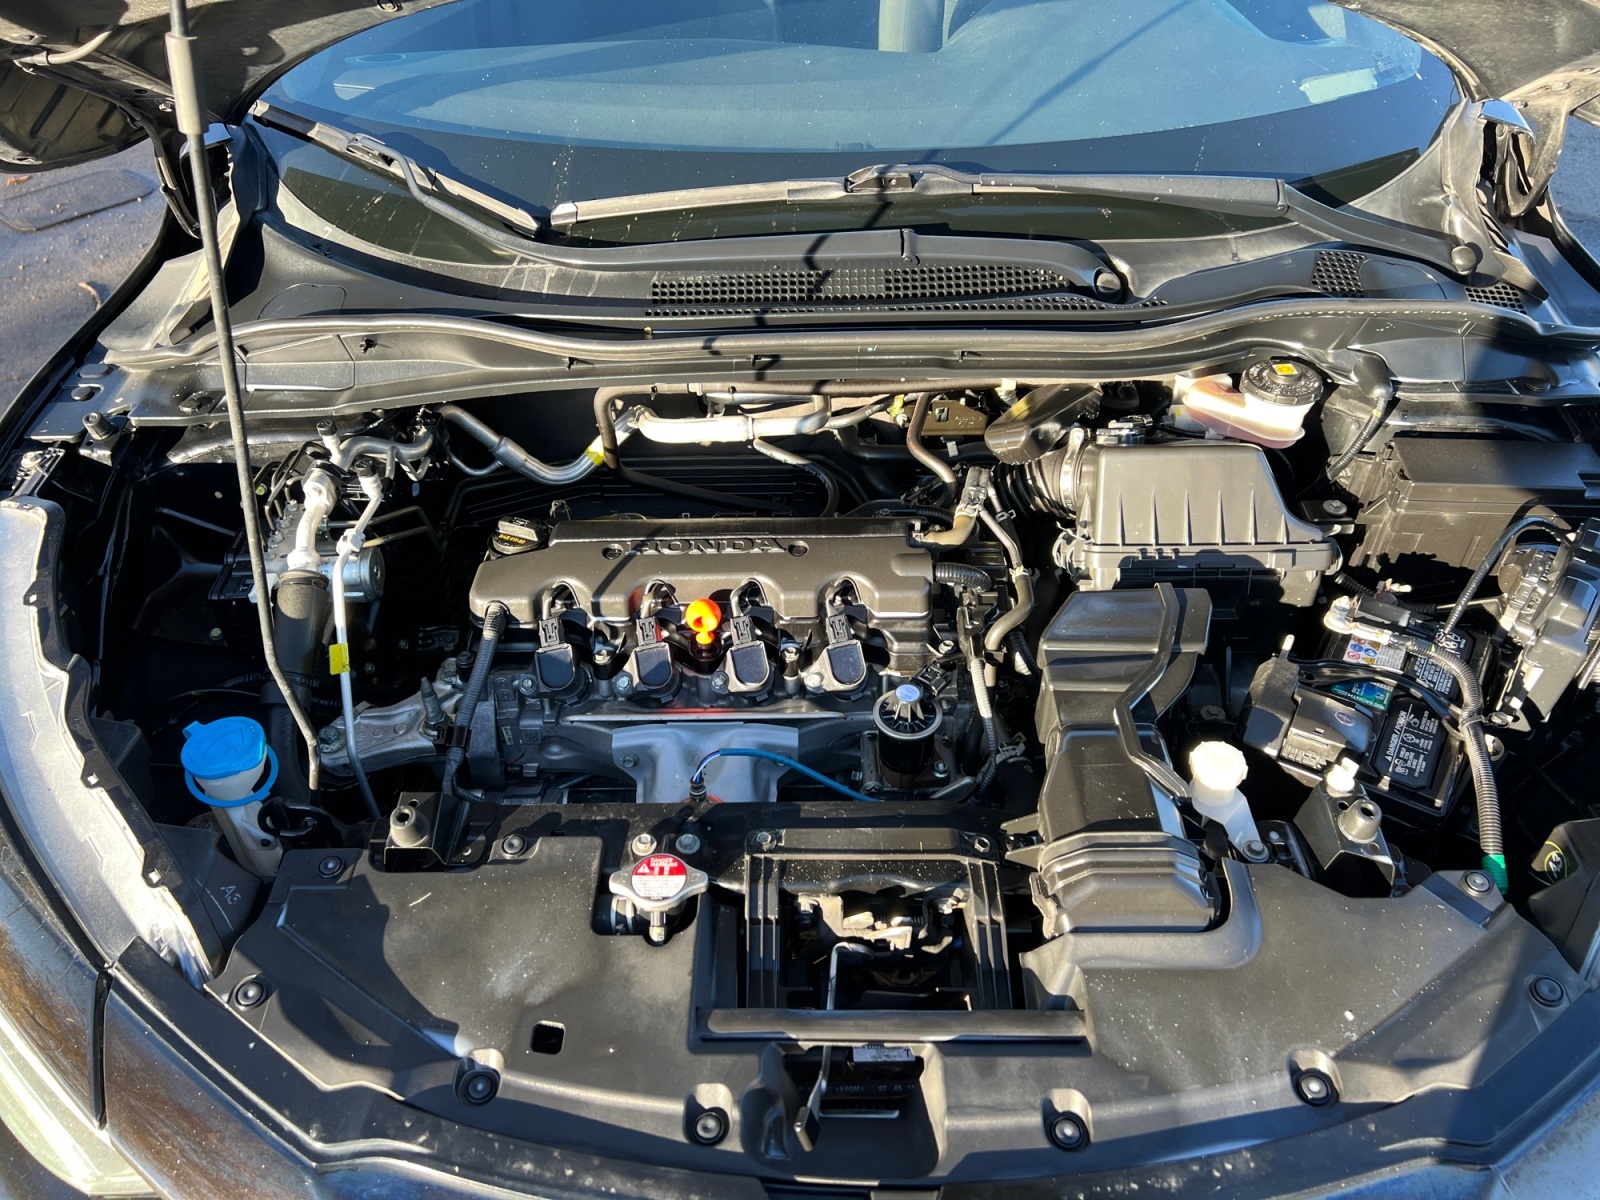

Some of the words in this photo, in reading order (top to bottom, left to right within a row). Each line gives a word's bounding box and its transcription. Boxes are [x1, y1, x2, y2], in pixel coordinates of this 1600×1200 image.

[625, 538, 786, 555] HONDA
[1347, 692, 1374, 705] MONTH
[1385, 732, 1399, 756] DANGER
[1394, 710, 1407, 731] POISON
[1548, 852, 1563, 879] A3
